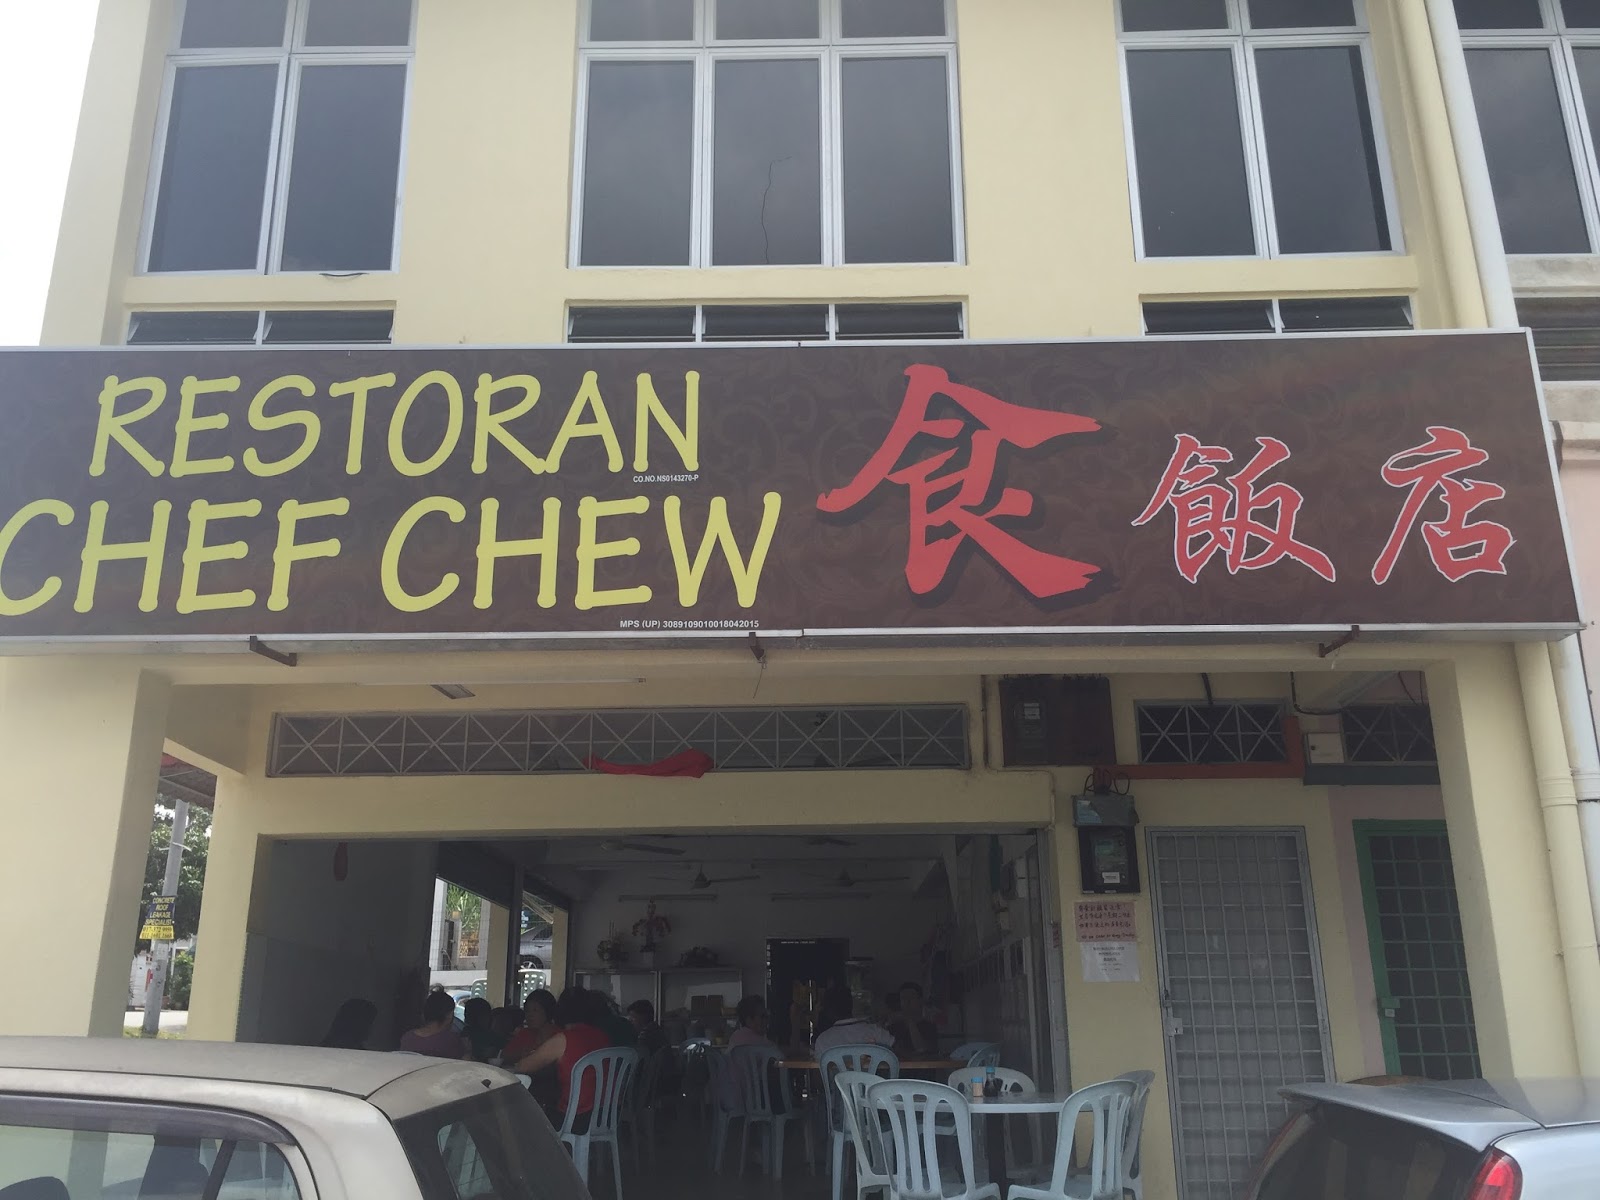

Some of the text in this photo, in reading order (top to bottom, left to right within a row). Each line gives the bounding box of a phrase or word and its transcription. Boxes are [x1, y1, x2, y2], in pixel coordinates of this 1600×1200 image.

[89, 370, 699, 477] RESTORAN
[0, 491, 782, 616] CHEF CHEW
[619, 620, 640, 628] MPS
[642, 620, 661, 629] (UP)
